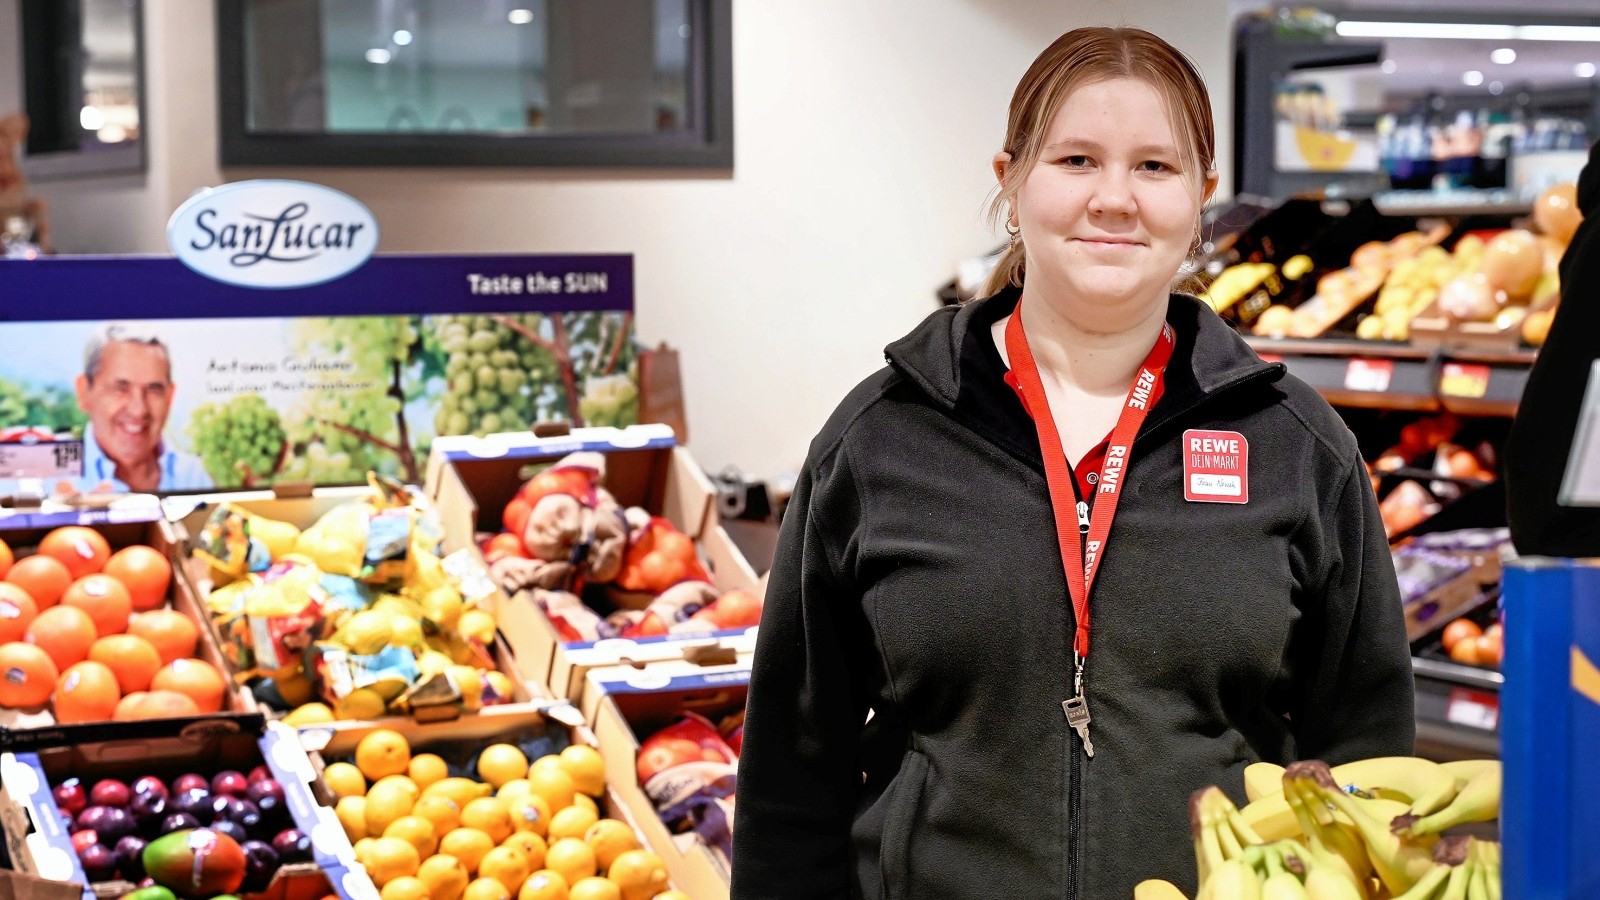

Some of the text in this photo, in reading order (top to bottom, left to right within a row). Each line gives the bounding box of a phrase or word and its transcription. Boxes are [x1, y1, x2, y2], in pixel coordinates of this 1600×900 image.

[190, 202, 364, 267] SanLucar
[466, 271, 608, 295] Taste the SUN
[1128, 367, 1155, 411] REWE
[1190, 437, 1240, 454] REWE
[1191, 453, 1239, 470] DEIN MARKT
[1099, 444, 1127, 495] REWE
